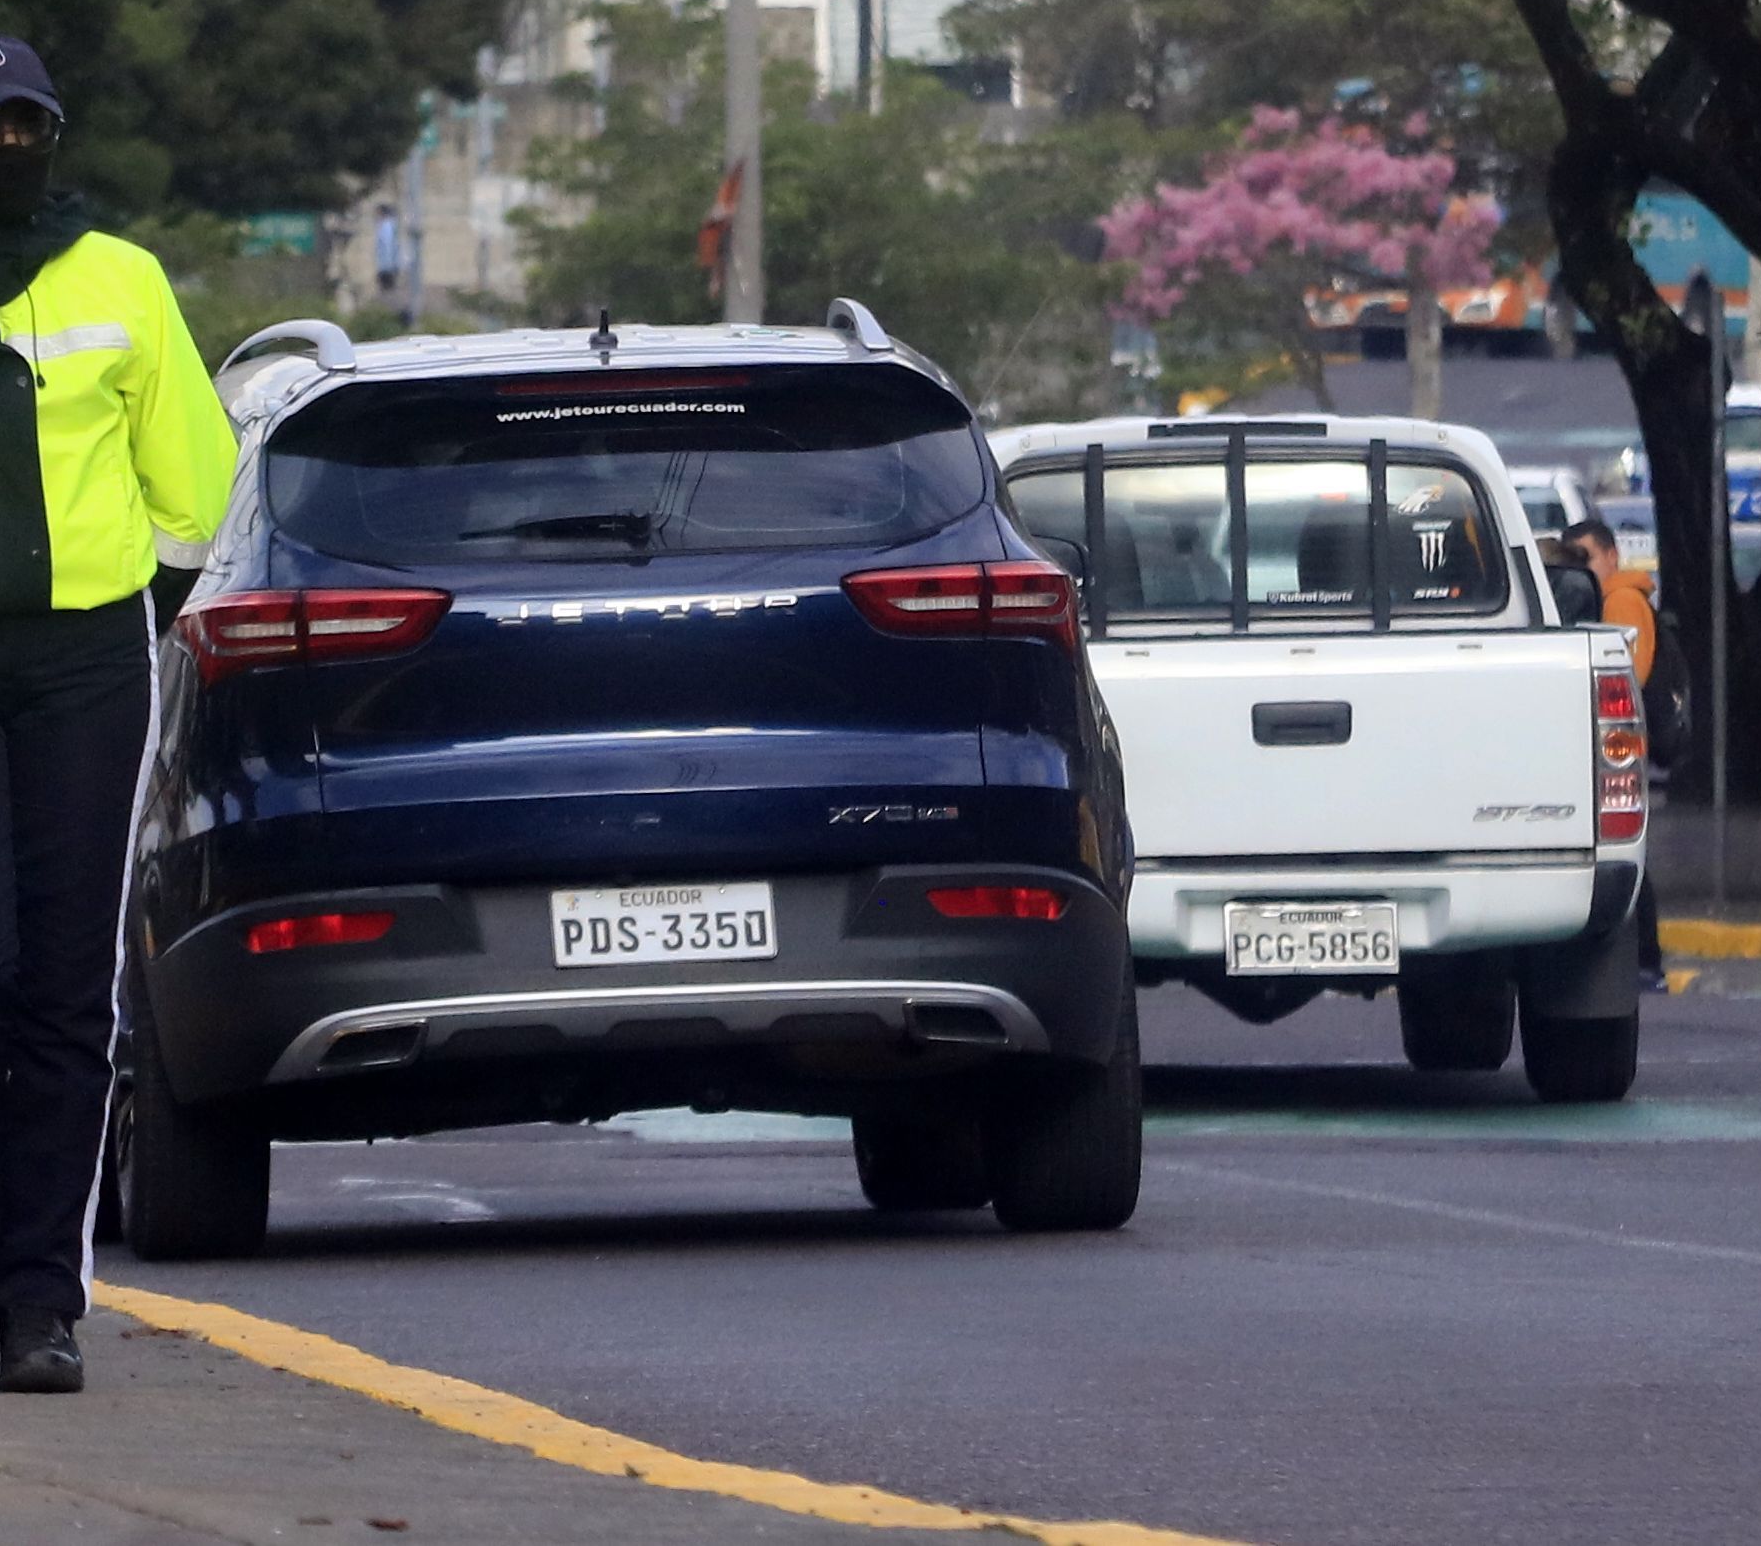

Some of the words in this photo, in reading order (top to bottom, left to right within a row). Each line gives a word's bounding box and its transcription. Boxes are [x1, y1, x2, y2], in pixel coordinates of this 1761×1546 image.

[496, 403, 746, 423] www.jetourecuador.com
[619, 889, 702, 907] ECUADOR
[1279, 911, 1345, 925] ECUADOR
[560, 910, 767, 955] PDS-3350
[1233, 931, 1390, 964] PCG-5856
